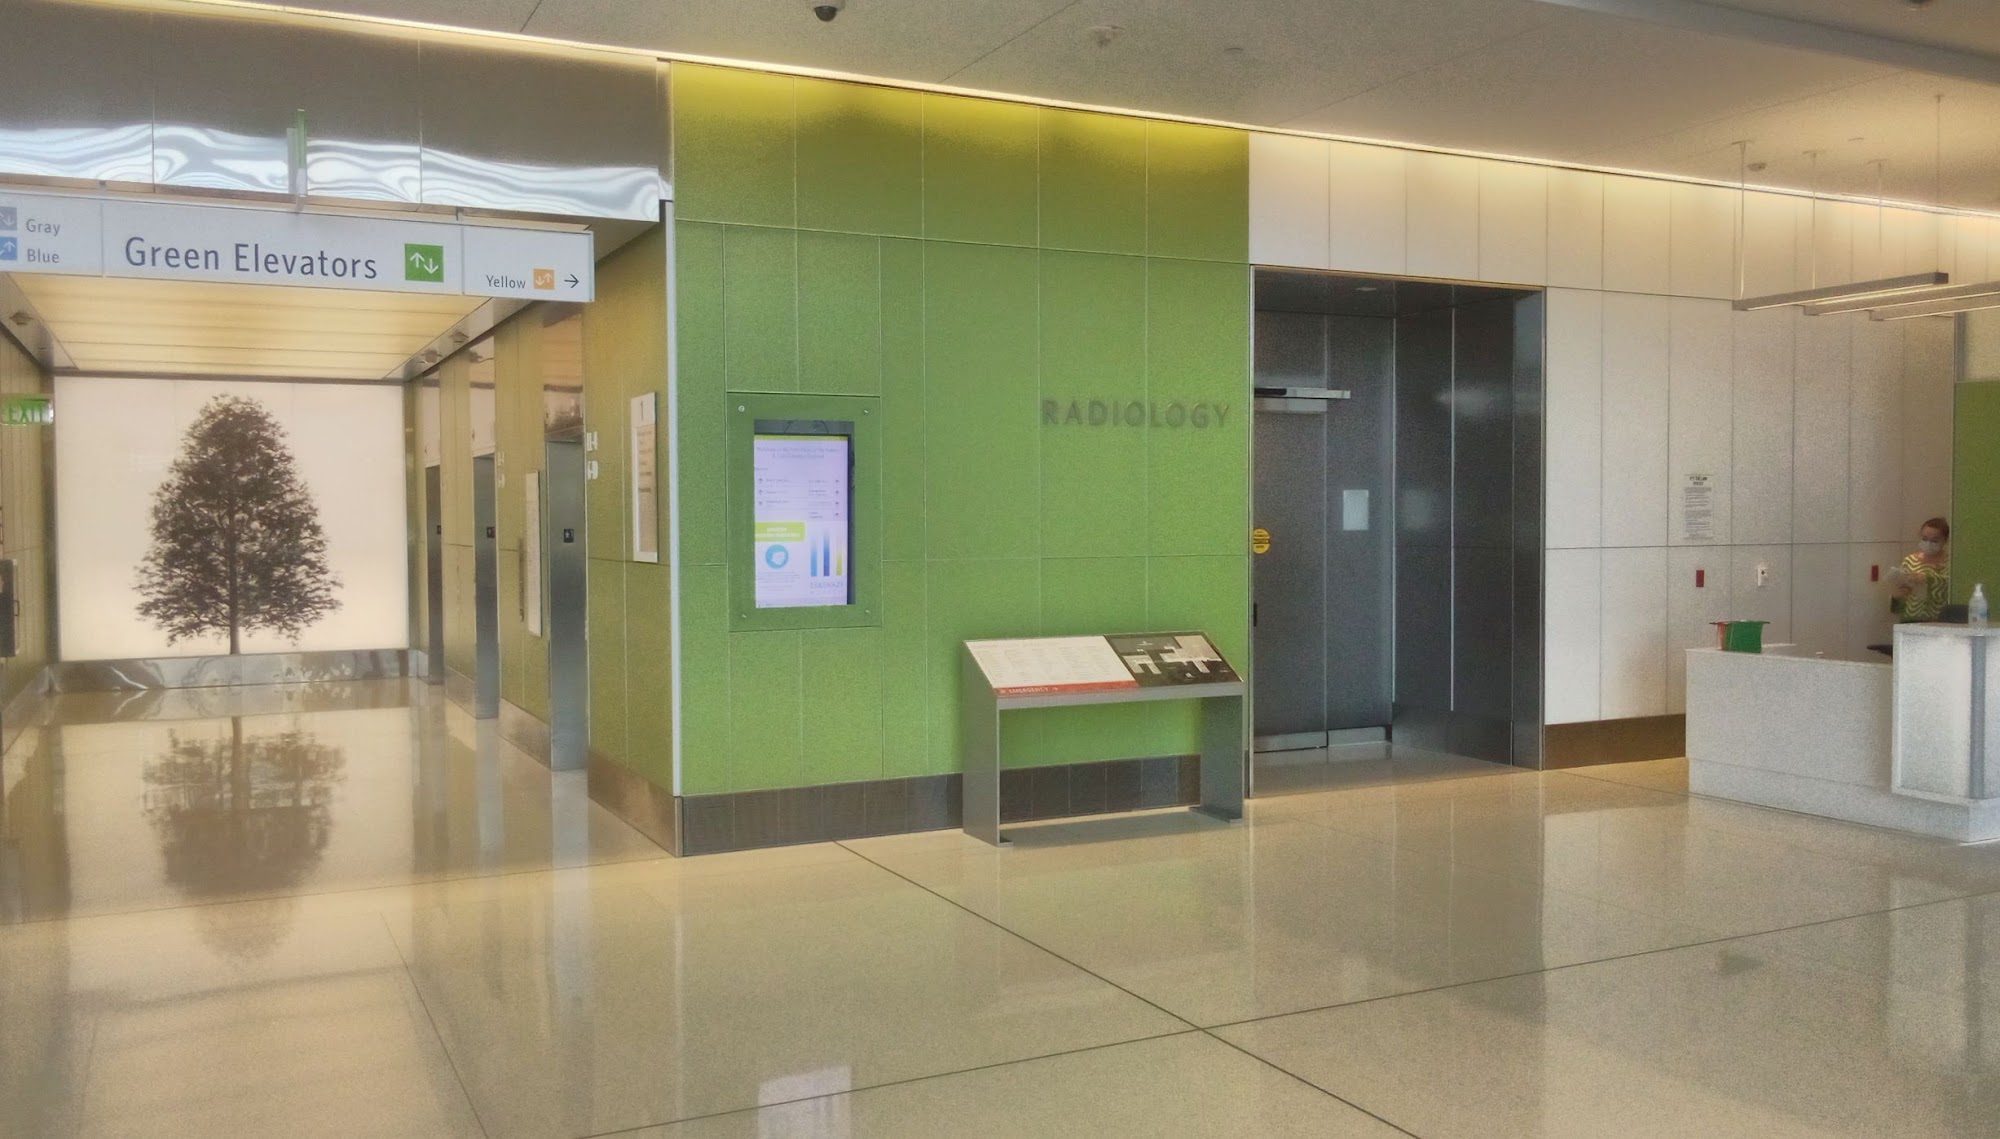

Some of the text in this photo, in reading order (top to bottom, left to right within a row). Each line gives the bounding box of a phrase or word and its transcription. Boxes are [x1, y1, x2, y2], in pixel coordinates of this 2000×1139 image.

[26, 219, 60, 237] Gray
[27, 249, 60, 263] Blue
[125, 236, 377, 279] Green Elevators
[486, 275, 526, 289] Yellow
[8, 403, 46, 423] EXIT
[1042, 400, 1230, 428] RADIOLOGY
